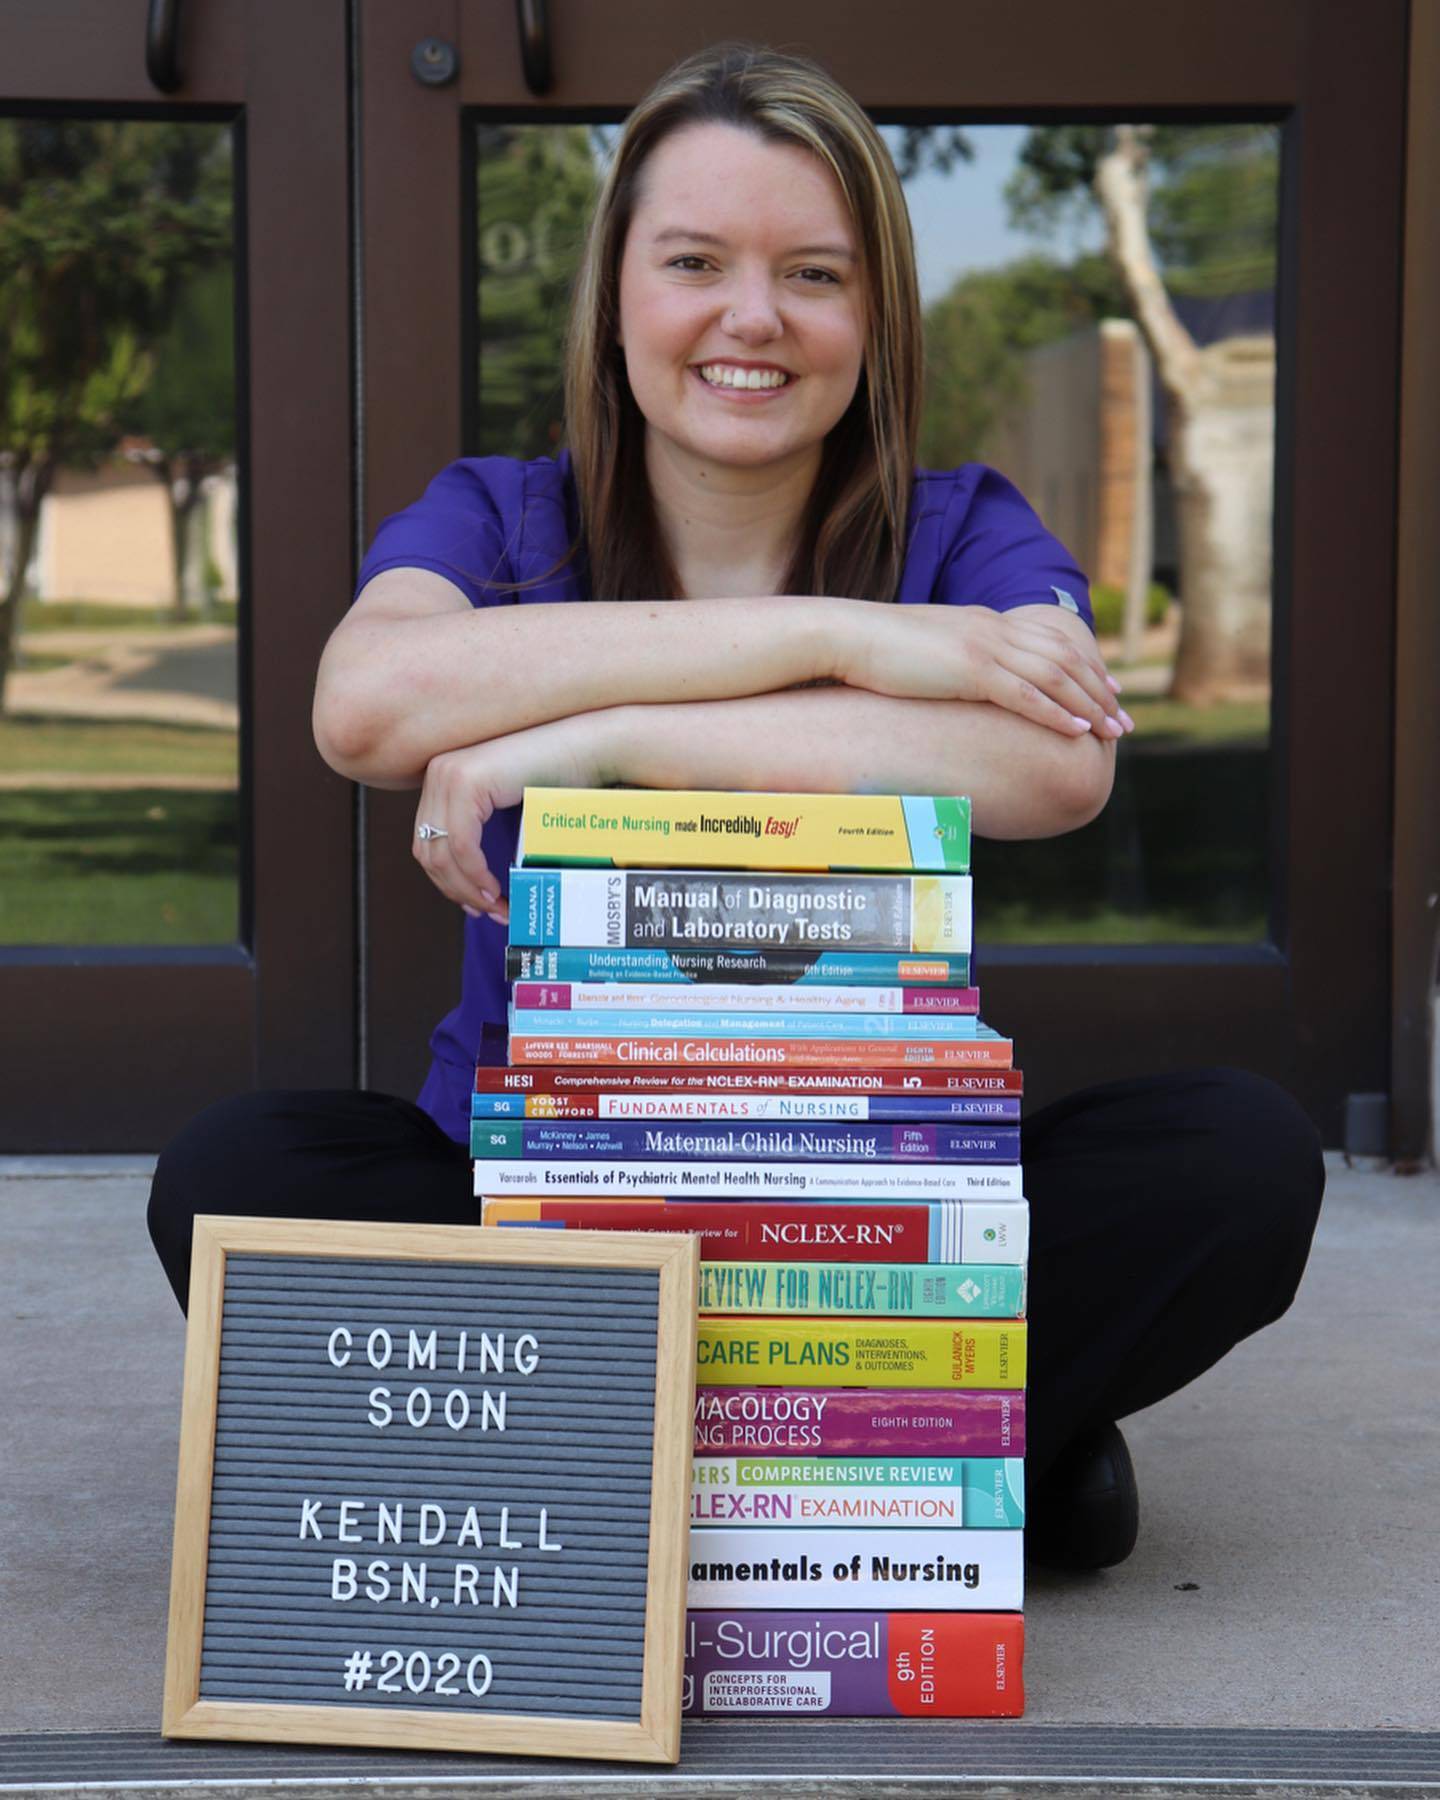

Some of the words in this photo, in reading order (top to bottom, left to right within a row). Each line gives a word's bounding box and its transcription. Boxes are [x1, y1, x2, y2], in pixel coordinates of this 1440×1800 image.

[542, 812, 586, 829] Critical
[589, 814, 617, 830] Care
[622, 816, 670, 836] Nursing
[674, 820, 697, 833] made
[700, 814, 761, 838] Incredibly
[838, 827, 864, 836] Fourth
[866, 828, 895, 837] Edition
[634, 885, 718, 909] Manual
[725, 886, 743, 909] of
[748, 887, 866, 914] Diagnostic
[528, 885, 538, 937] PAGANA
[546, 885, 556, 937] PAGANA
[607, 876, 622, 945] MOSBY'S
[633, 919, 665, 938] and
[671, 915, 789, 944] Laboratory
[795, 917, 852, 940] Tests
[547, 951, 558, 980] BURNS
[589, 952, 669, 972] Understanding
[672, 954, 713, 970] Nursing
[716, 954, 766, 970] Research
[804, 963, 821, 976] 6th
[824, 964, 853, 976] Edition
[900, 966, 946, 976] ELSEVIER
[789, 993, 832, 1006] Healthy
[834, 994, 866, 1007] Aging
[913, 997, 960, 1007] ELSEVIER
[651, 1017, 702, 1029] Delegation
[720, 1018, 785, 1030] Management
[525, 1051, 553, 1059] WOODS
[558, 1051, 598, 1059] FORRESTER
[616, 1041, 678, 1062] Clinical
[683, 1042, 785, 1063] Calculations
[944, 1050, 990, 1060] ELSEVIER
[504, 1074, 533, 1088] HESI
[554, 1075, 630, 1087] Comprehensive
[633, 1075, 668, 1086] Review
[670, 1075, 685, 1086] for
[687, 1075, 704, 1086] the
[788, 1076, 883, 1089] EXAMINATION
[947, 1077, 1006, 1089] ELSEVIER
[493, 1101, 510, 1112] SG
[532, 1097, 569, 1106] YOOST
[608, 1100, 749, 1115] FUNDAMENTALS
[756, 1099, 772, 1114] of
[780, 1101, 859, 1116] NURSING
[950, 1103, 1004, 1114] ELSEVIER
[532, 1107, 594, 1117] CRAWFORD
[490, 1134, 507, 1145] SG
[540, 1130, 577, 1142] McKinney
[585, 1130, 610, 1140] James
[645, 1130, 793, 1153] Maternal-Child
[800, 1132, 876, 1157] Nursing
[903, 1130, 923, 1141] Fifth
[527, 1140, 554, 1151] Murray
[562, 1140, 589, 1151] Nelson
[596, 1141, 623, 1151] Ashwill
[900, 1142, 929, 1153] Edition
[950, 1140, 997, 1150] ELSEVIER
[545, 1170, 599, 1185] Essentials
[603, 1170, 615, 1185] of
[618, 1171, 677, 1188] Psychiatric
[681, 1171, 720, 1185] Mental
[724, 1172, 760, 1186] Health
[764, 1172, 806, 1189] Nursing
[966, 1177, 984, 1188] Third
[986, 1177, 1011, 1188] Edition
[724, 1228, 738, 1238] for
[776, 1268, 808, 1309] FOR
[819, 1269, 914, 1310] NCLEX-RN
[923, 1278, 934, 1303] EIGHTH
[935, 1276, 946, 1305] EDITION
[327, 1327, 540, 1375] COMING
[855, 1338, 908, 1349] DIAGNOSES,
[697, 1341, 760, 1365] CARE
[769, 1341, 850, 1366] PLANS
[855, 1350, 928, 1361] INTERVENTIONS,
[952, 1330, 963, 1381] GULANICK
[965, 1338, 976, 1374] MYERS
[1000, 1333, 1008, 1379] ELSEVIER
[855, 1361, 863, 1371] &
[865, 1361, 914, 1371] OUTCOMES
[367, 1386, 507, 1431] SOON
[871, 1416, 908, 1428] EIGHTH
[911, 1417, 953, 1428] EDITION
[1001, 1399, 1011, 1447] ELSEVIER
[732, 1424, 822, 1447] PROCESS
[741, 1466, 886, 1482] COMPREHENSIVE
[890, 1466, 954, 1482] REVIEW
[995, 1469, 1004, 1520] ELSEVIER
[690, 1494, 792, 1519] LEX-RN
[800, 1499, 954, 1518] EXAMINATION
[299, 1498, 562, 1551] KENDALL
[688, 1555, 823, 1582] amentals
[832, 1555, 861, 1582] of
[871, 1556, 980, 1589] Nursing
[682, 1620, 880, 1668] l-Surgical
[343, 1649, 494, 1698] #2020
[897, 1651, 915, 1681] 9th
[920, 1628, 935, 1703] EDITION
[996, 1643, 1006, 1691] ELSEVIER
[708, 1674, 763, 1685] CONCEPTS
[767, 1674, 787, 1685] FOR
[708, 1685, 817, 1696] INTERPROFESSIONAL
[708, 1696, 792, 1707] COLLABORATIVE
[796, 1696, 824, 1707] CARE
